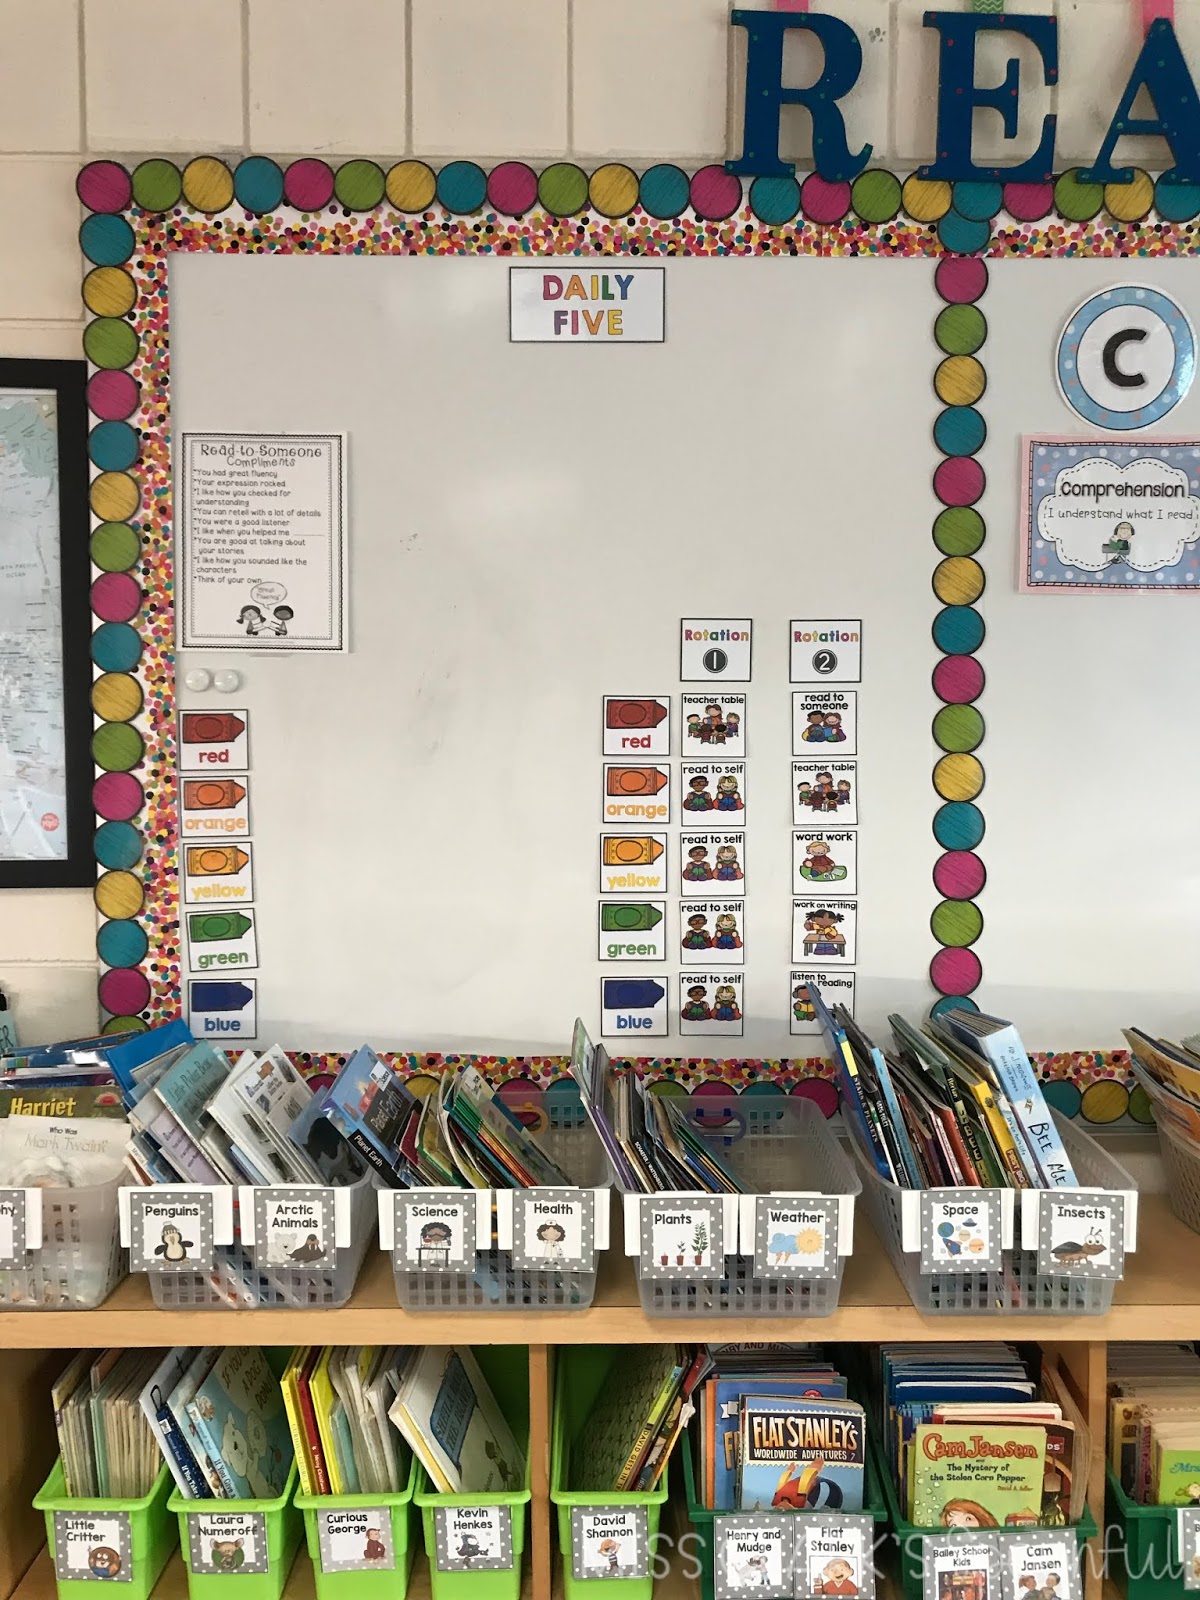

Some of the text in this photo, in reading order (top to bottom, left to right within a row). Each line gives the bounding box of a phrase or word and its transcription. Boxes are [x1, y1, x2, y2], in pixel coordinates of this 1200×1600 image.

[543, 274, 634, 300] DAILY
[554, 309, 623, 335] FIVE
[1102, 328, 1147, 387] C
[227, 456, 296, 468] Compliments
[229, 470, 249, 478] great
[252, 470, 278, 478] fluency
[217, 480, 286, 488] expression rocked
[202, 488, 292, 498] like how you checked for
[1061, 482, 1186, 503] Comprehension
[196, 499, 250, 507] understanding
[229, 508, 250, 516] retell
[1048, 507, 1193, 520] I understand what I read
[242, 519, 260, 527] good
[252, 528, 276, 536] helped
[229, 538, 248, 546] good
[260, 538, 284, 546] talking
[198, 548, 216, 556] your
[202, 556, 214, 564] like
[216, 556, 230, 564] how
[233, 558, 246, 566] you
[248, 557, 280, 565] sounded
[296, 558, 308, 566] the
[196, 566, 236, 574] characters
[684, 628, 749, 642] Rotation
[794, 630, 859, 643] Rotation
[819, 652, 830, 670] 2
[684, 696, 744, 704] teacher table
[804, 692, 844, 702] read to
[800, 702, 848, 711] someone
[621, 735, 651, 748] red
[199, 749, 229, 763] red
[683, 764, 744, 774] read to self
[794, 763, 856, 772] teacher table
[606, 801, 668, 819] orange
[184, 817, 246, 832] orange
[682, 834, 742, 844] read to self
[796, 832, 854, 842] word work
[606, 873, 661, 890] yellow
[192, 883, 246, 900] yellow
[682, 902, 742, 912] read to self
[794, 901, 814, 909] work
[826, 902, 856, 911] writing
[606, 942, 657, 958] green
[198, 952, 249, 969] green
[682, 974, 742, 984] read to self
[792, 972, 816, 982] listen
[818, 979, 853, 988] reading
[204, 1018, 241, 1032] blue
[616, 1014, 653, 1030] blue
[10, 1097, 77, 1118] Harriet
[852, 1077, 879, 1142] STARS PLANETS
[49, 1126, 78, 1136] Who Was
[354, 1135, 383, 1168] Planet Earth
[1028, 1122, 1066, 1186] BEE ME
[1007, 1149, 1020, 1169] FIRST
[145, 1206, 198, 1218] Penguins
[276, 1204, 314, 1215] Arctic
[412, 1206, 458, 1218] Science
[534, 1203, 574, 1215] Health
[942, 1204, 978, 1217] Space
[1058, 1206, 1106, 1220] Insects
[272, 1217, 318, 1228] Animals
[654, 1214, 692, 1225] Plants
[770, 1211, 824, 1224] Weather
[752, 1416, 785, 1448] FLAT
[623, 1429, 651, 1471] DAVID GETS
[922, 1433, 1038, 1461] Cam Jansen
[754, 1448, 847, 1460] WORLDWIDE ADVENTURES
[964, 1464, 998, 1472] Mystery
[996, 1474, 1026, 1483] Popper
[188, 1480, 199, 1494] Take
[222, 1477, 236, 1493] Give
[326, 1512, 368, 1524] Curious
[457, 1508, 488, 1518] Kevin
[65, 1520, 95, 1530] Little
[210, 1515, 244, 1525] Laura
[454, 1520, 493, 1530] Henkes
[593, 1515, 626, 1526] David
[199, 1526, 258, 1536] Numeroff
[328, 1524, 367, 1535] George
[586, 1527, 634, 1539] Shannon
[821, 1526, 844, 1538] Flat
[66, 1532, 106, 1542] Critter
[727, 1530, 781, 1542] Henry and
[736, 1542, 772, 1554] Mudge
[810, 1540, 855, 1554] Stanley
[934, 1547, 990, 1558] Bailey School
[1026, 1546, 1053, 1557] Cam
[953, 1558, 971, 1567] Kids
[1021, 1559, 1062, 1572] Jansen
